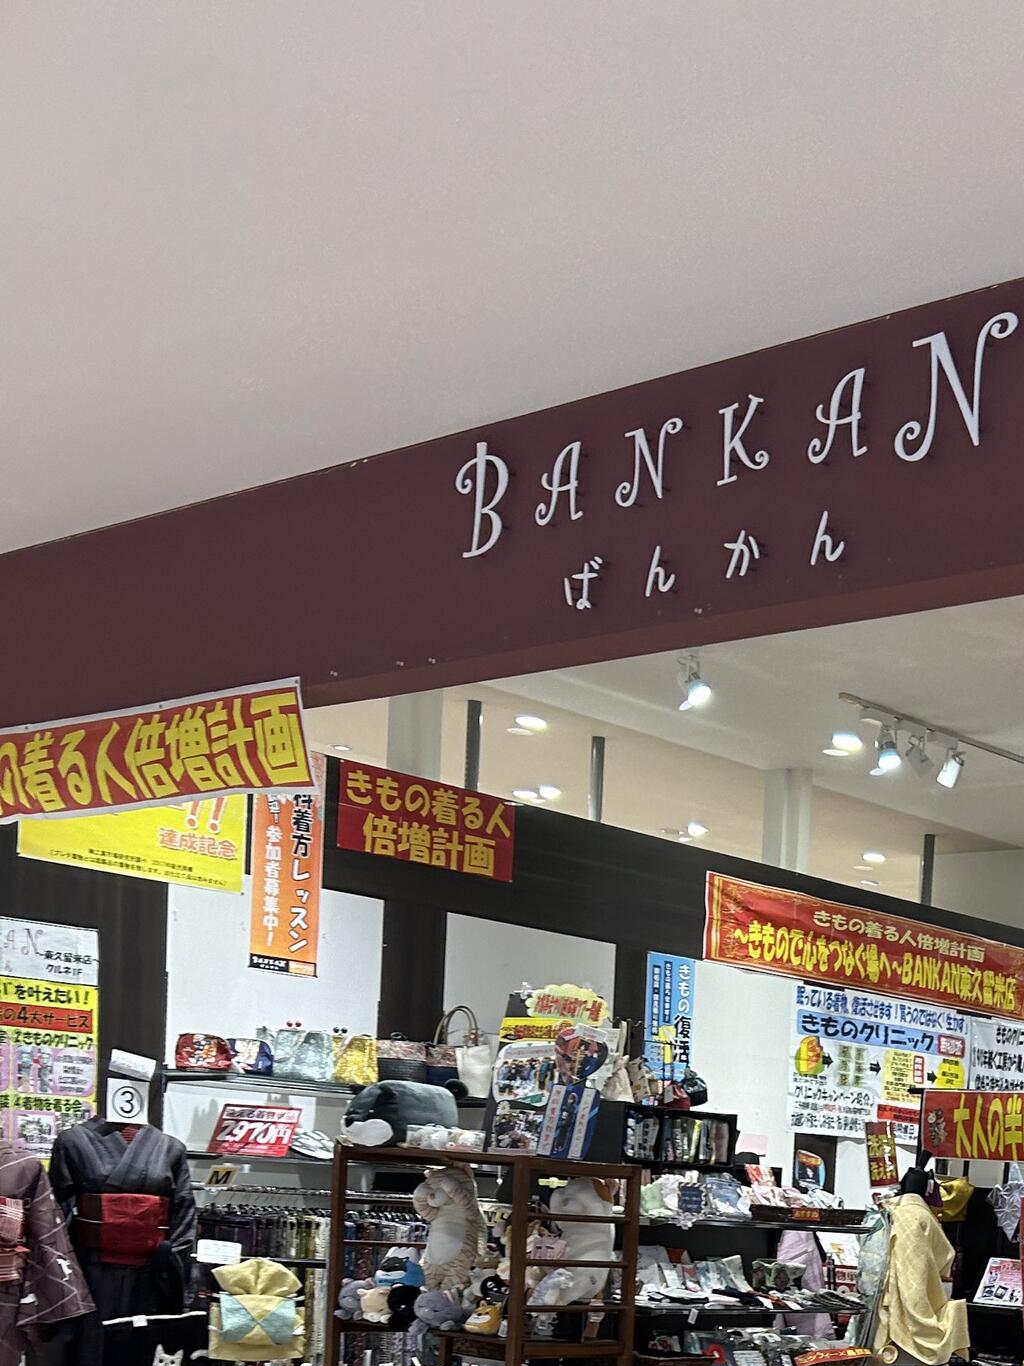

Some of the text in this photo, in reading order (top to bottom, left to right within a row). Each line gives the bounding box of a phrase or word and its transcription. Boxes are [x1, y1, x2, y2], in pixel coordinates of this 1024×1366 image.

[455, 311, 1019, 558] BANKAN
[564, 510, 845, 610] ばんかん
[346, 770, 511, 839] きもの着る人
[159, 826, 238, 860] 達成記念
[362, 812, 497, 877] 倍増計画
[812, 909, 986, 964] きもの着る人倍増計画
[801, 1013, 935, 1052] きものクリニック
[208, 1170, 233, 1185] M
